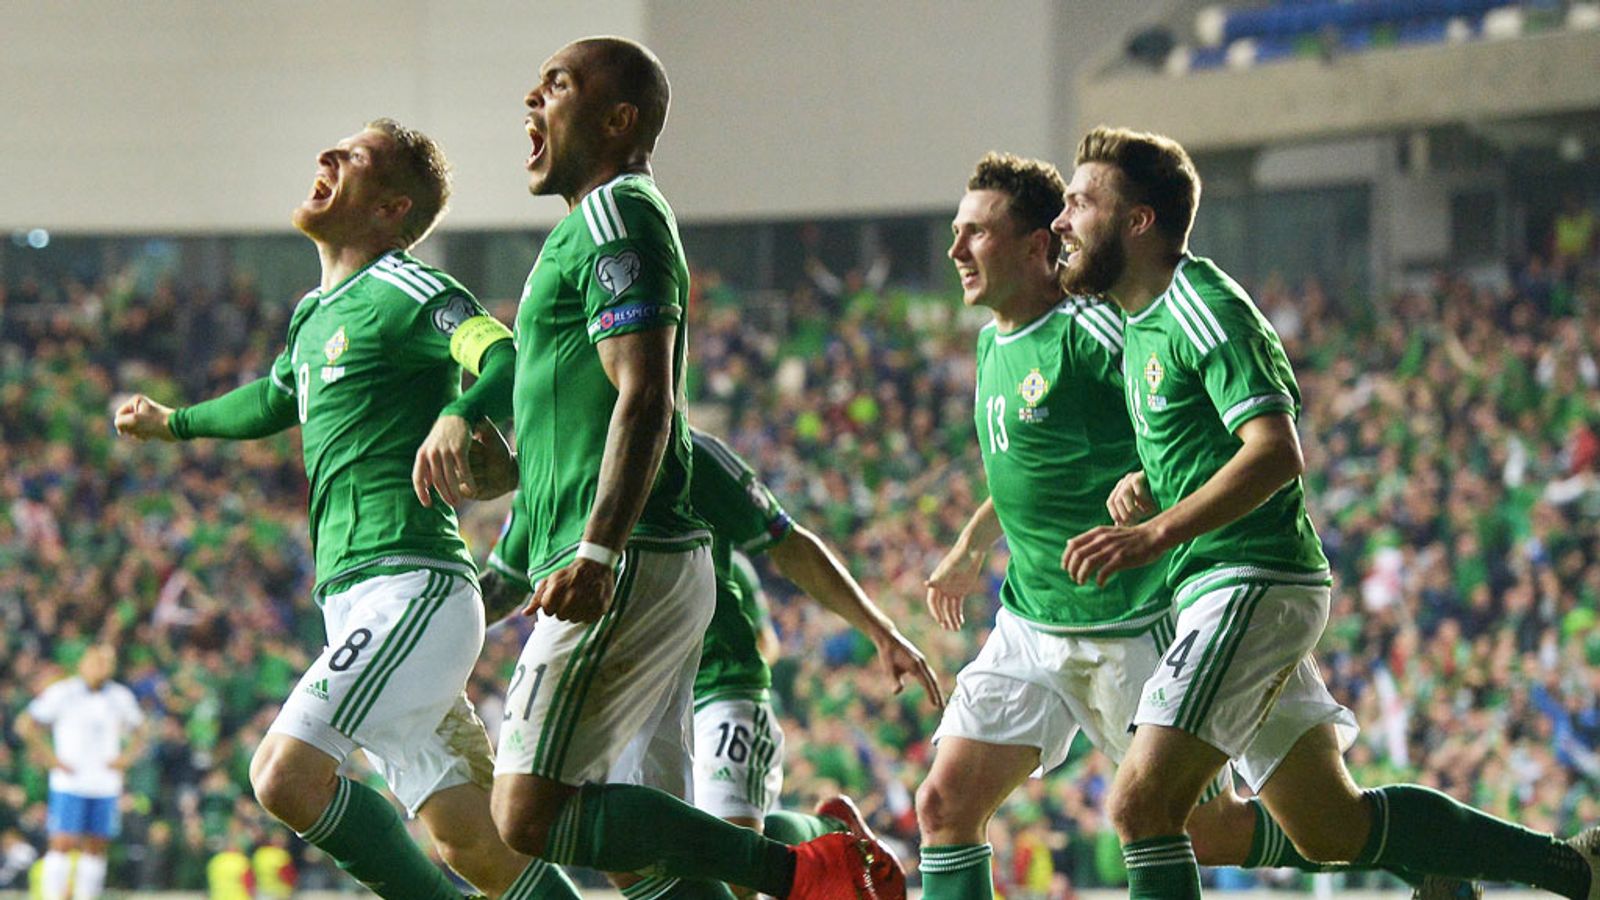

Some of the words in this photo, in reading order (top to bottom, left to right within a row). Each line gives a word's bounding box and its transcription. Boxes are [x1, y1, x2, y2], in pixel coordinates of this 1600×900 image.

[614, 306, 656, 322] RESPECT
[298, 362, 310, 425] 8
[986, 394, 1010, 454] 13
[328, 627, 373, 672] 8
[1166, 629, 1200, 679] 4
[715, 721, 750, 764] 16
